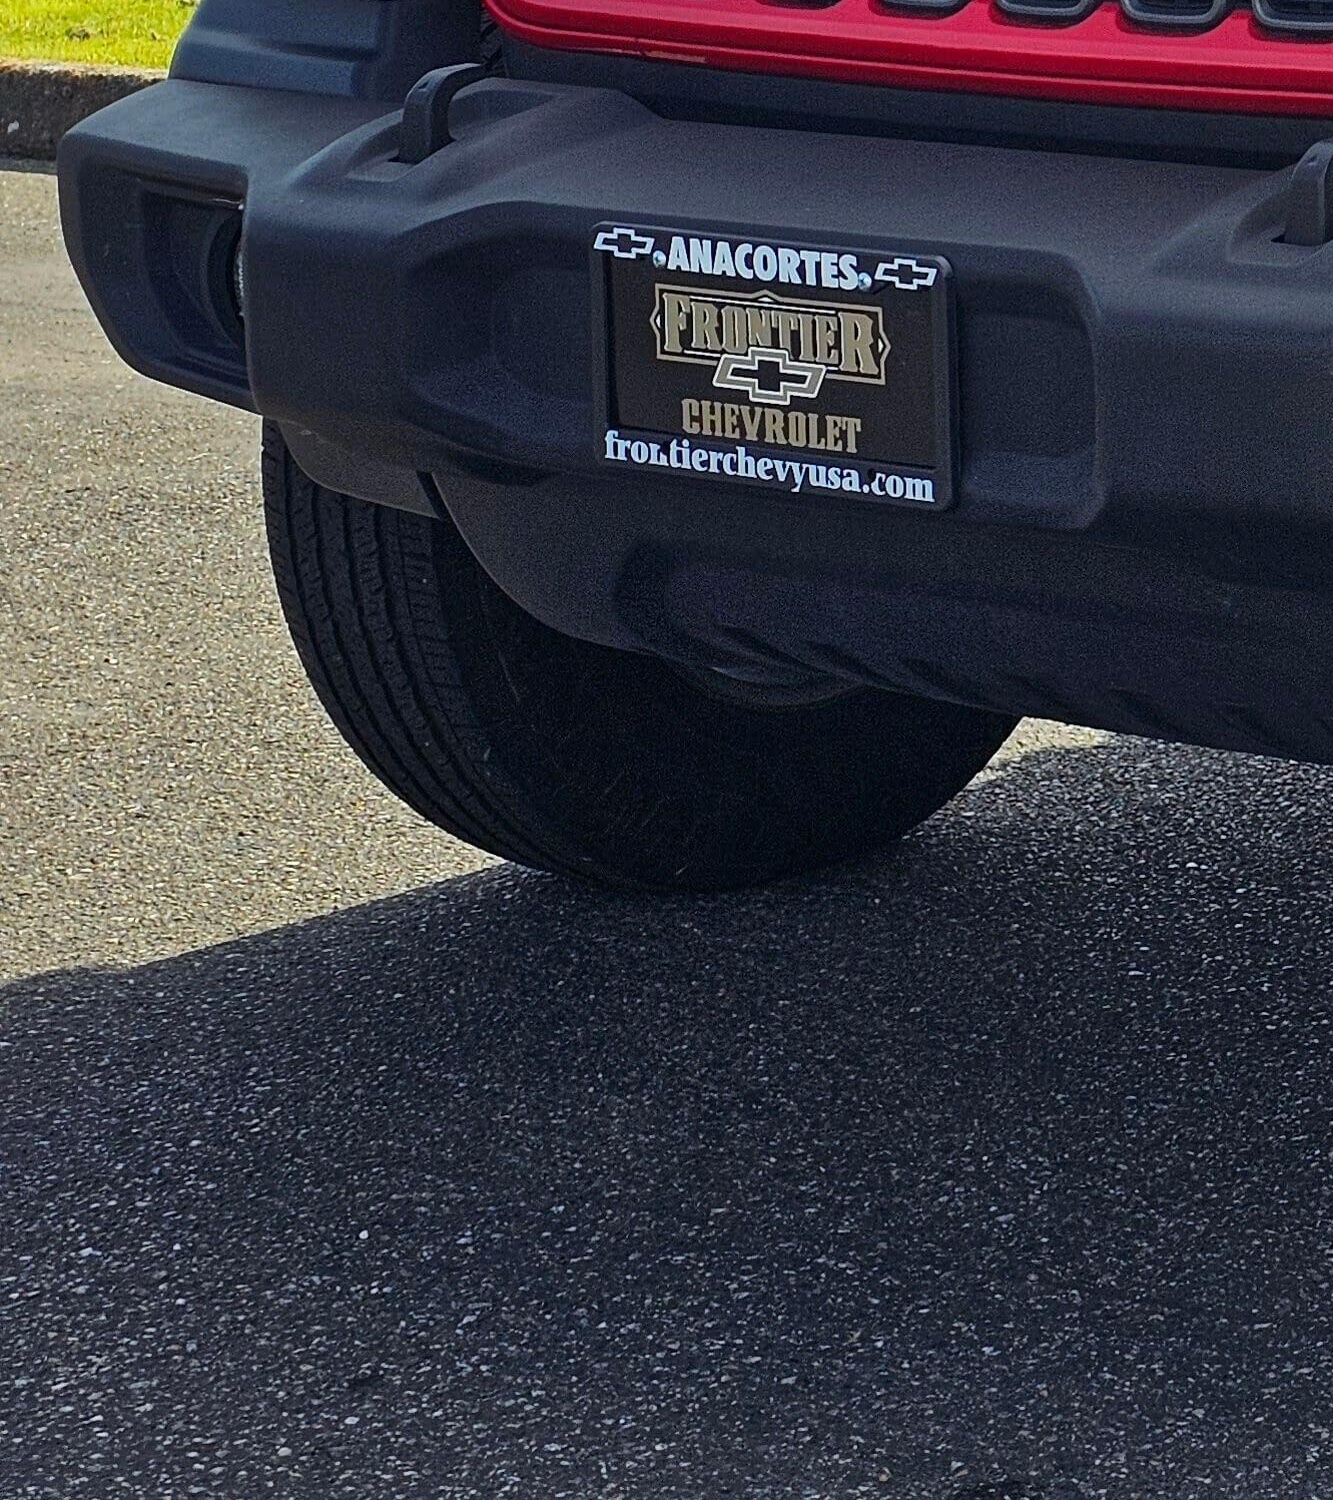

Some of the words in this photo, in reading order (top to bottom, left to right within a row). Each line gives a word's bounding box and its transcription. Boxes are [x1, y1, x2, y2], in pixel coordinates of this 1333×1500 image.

[666, 236, 859, 290] ANACORTES
[663, 293, 879, 375] FRONTIER
[681, 398, 862, 454] CHEVROLET
[604, 429, 935, 503] frontierchevyusa.com
